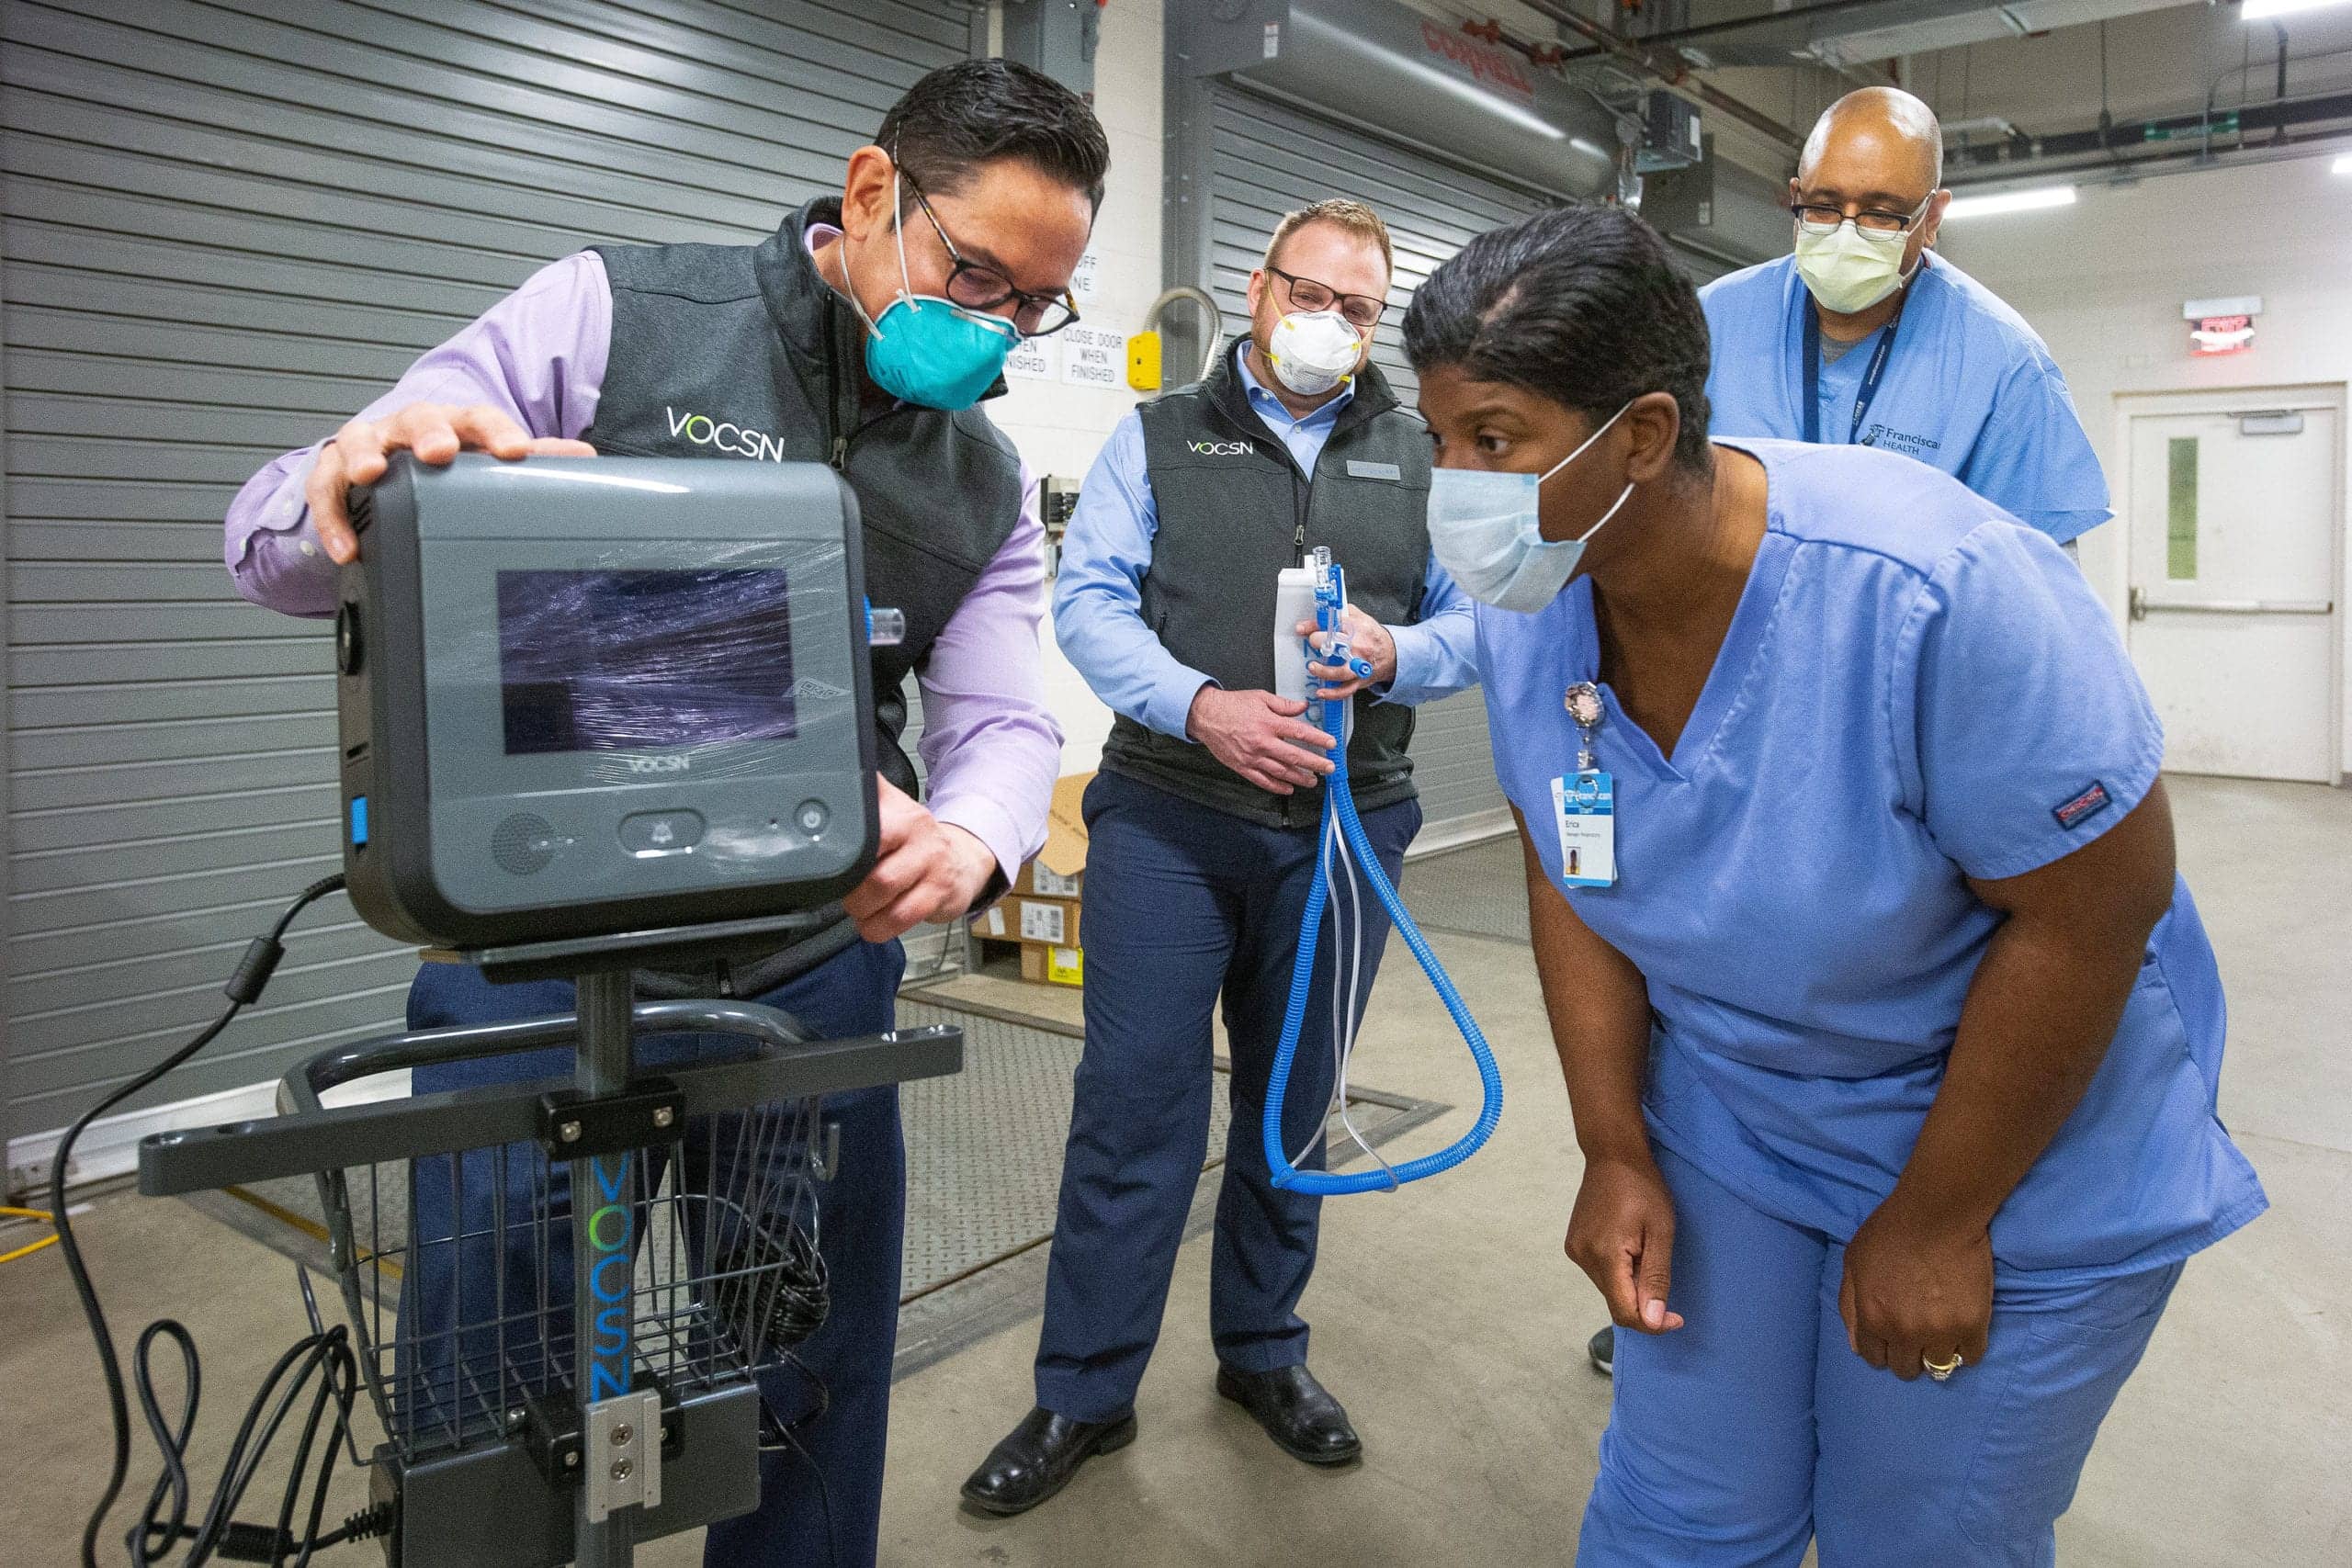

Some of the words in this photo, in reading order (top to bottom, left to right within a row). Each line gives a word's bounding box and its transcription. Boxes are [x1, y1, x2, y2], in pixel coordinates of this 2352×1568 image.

[1063, 328, 1094, 345] CLOSE
[1097, 333, 1123, 349] DOOR
[1006, 355, 1046, 373] NISHED
[1080, 348, 1108, 365] WHEN
[1071, 365, 1115, 383] FINISHED
[666, 405, 785, 463] VOCSN
[1187, 440, 1253, 456] VOCSN
[1883, 440, 1920, 456] HEALTH
[628, 754, 690, 773] VOCSN
[588, 1150, 632, 1405] VOCSN
